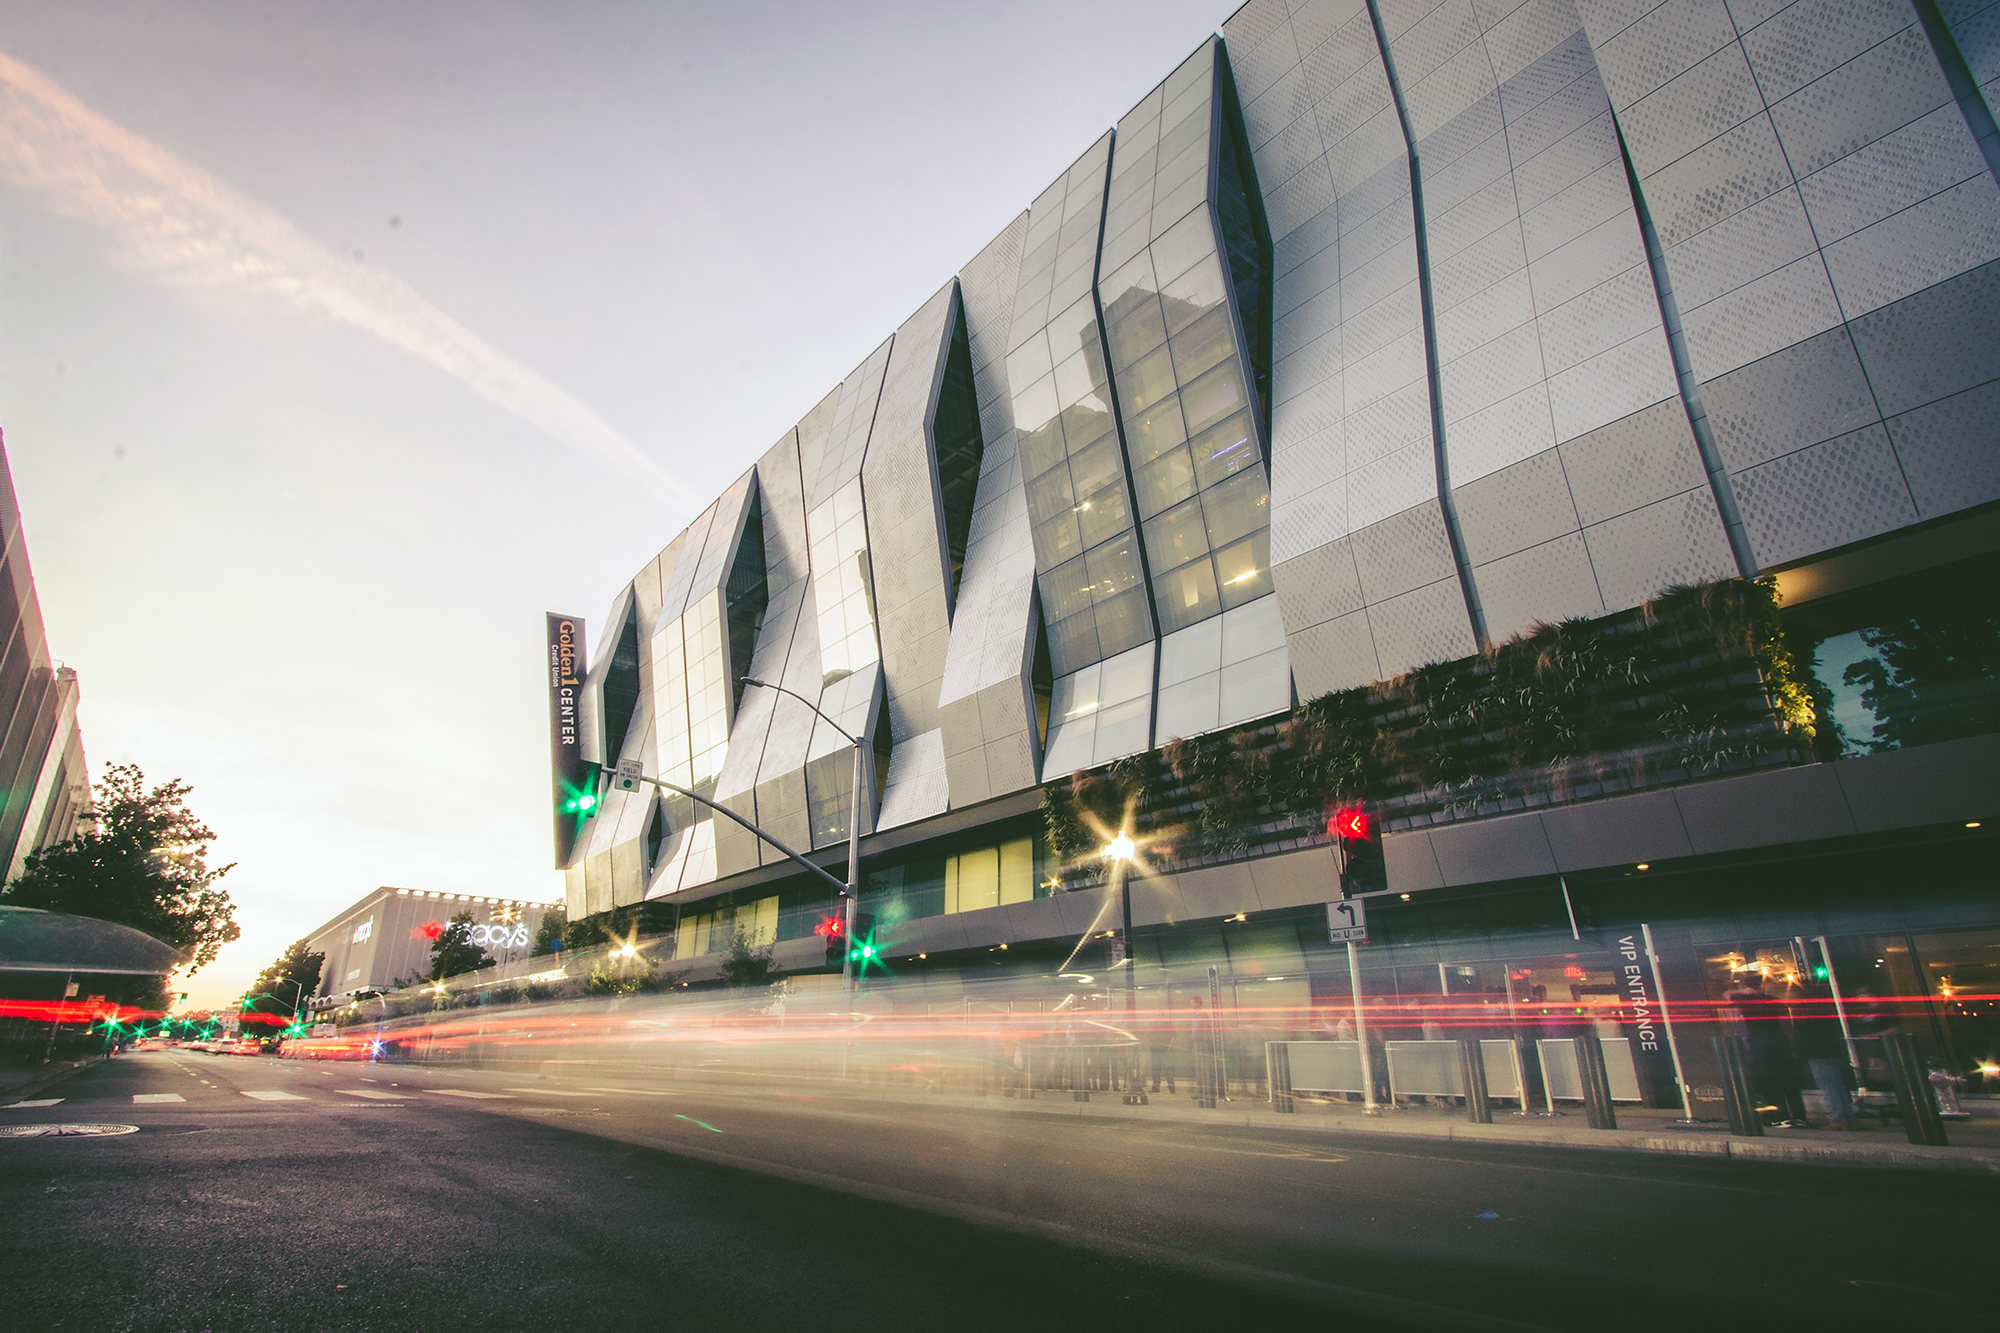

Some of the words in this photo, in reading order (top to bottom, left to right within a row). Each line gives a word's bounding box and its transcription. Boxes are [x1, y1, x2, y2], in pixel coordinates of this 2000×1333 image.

[551, 644, 559, 665] Credit
[559, 620, 575, 676] Golden
[552, 667, 560, 687] Union
[560, 688, 575, 745] CENTER
[1343, 930, 1350, 939] U
[1618, 935, 1637, 961] VIP
[1624, 965, 1658, 1051] ENTRANCE
